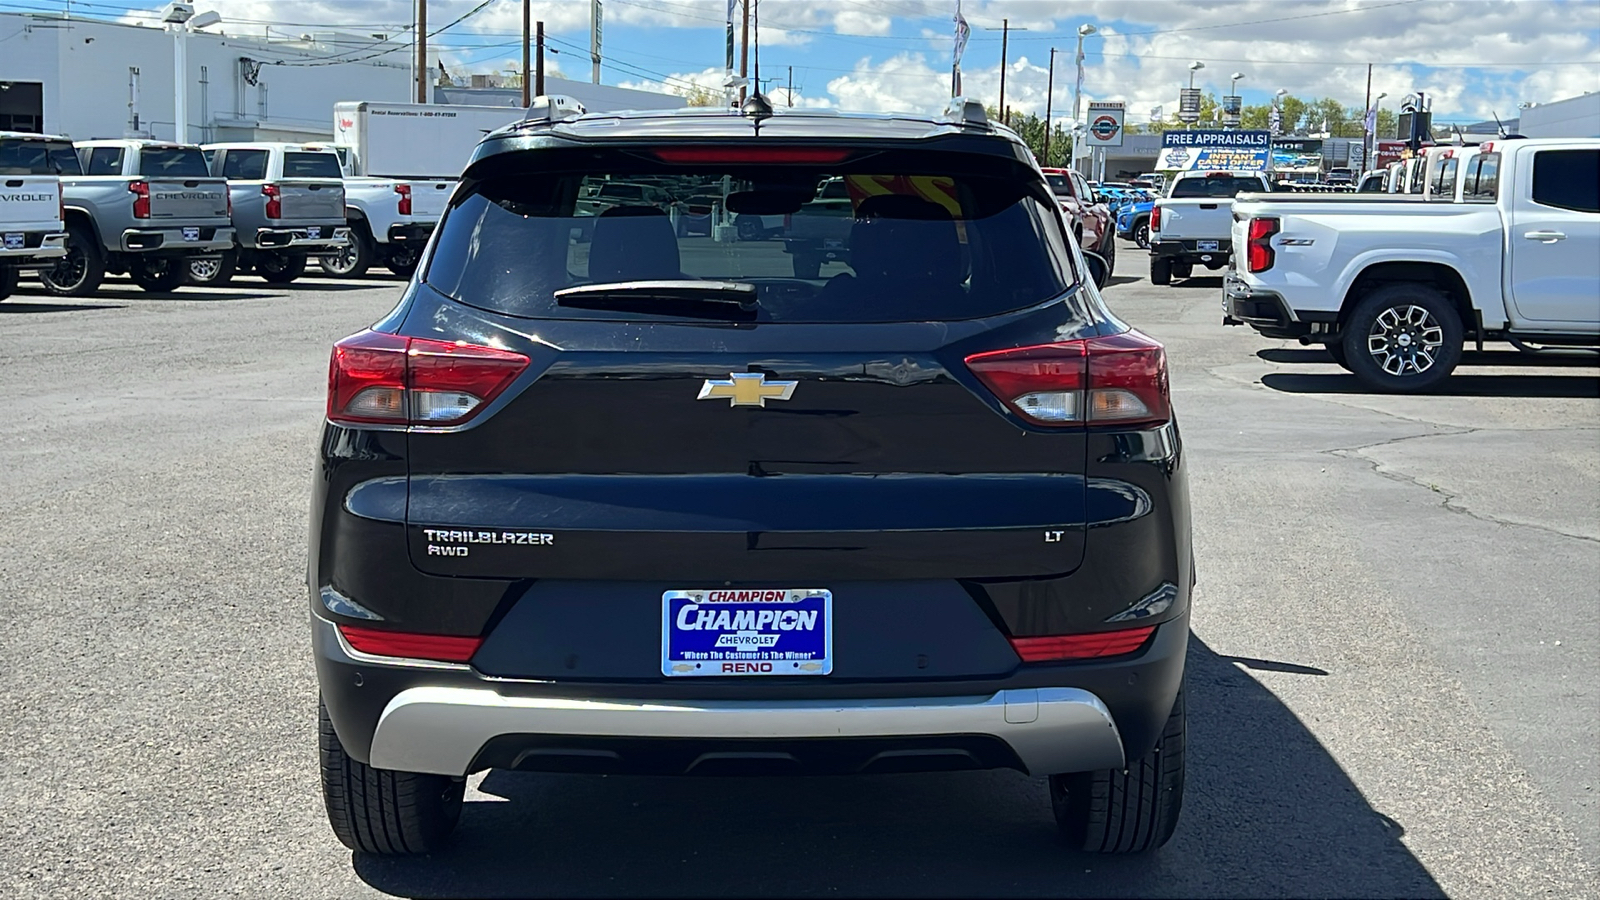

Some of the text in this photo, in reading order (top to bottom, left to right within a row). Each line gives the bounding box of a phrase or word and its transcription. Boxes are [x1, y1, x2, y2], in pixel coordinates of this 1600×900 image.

[1166, 134, 1268, 145] FREE APPRAISALS!
[0, 194, 54, 202] VROLET
[423, 529, 554, 545] TRAILBLAZER
[1044, 530, 1065, 542] LT
[427, 544, 469, 557] AWD
[708, 591, 786, 603] CHAMPION
[676, 604, 818, 631] CHAMPION
[719, 636, 775, 645] CHEVROLET
[710, 651, 724, 660] The
[725, 651, 760, 660] Customer
[761, 651, 769, 660] Is
[770, 651, 784, 660] The
[721, 662, 773, 673] RENO
